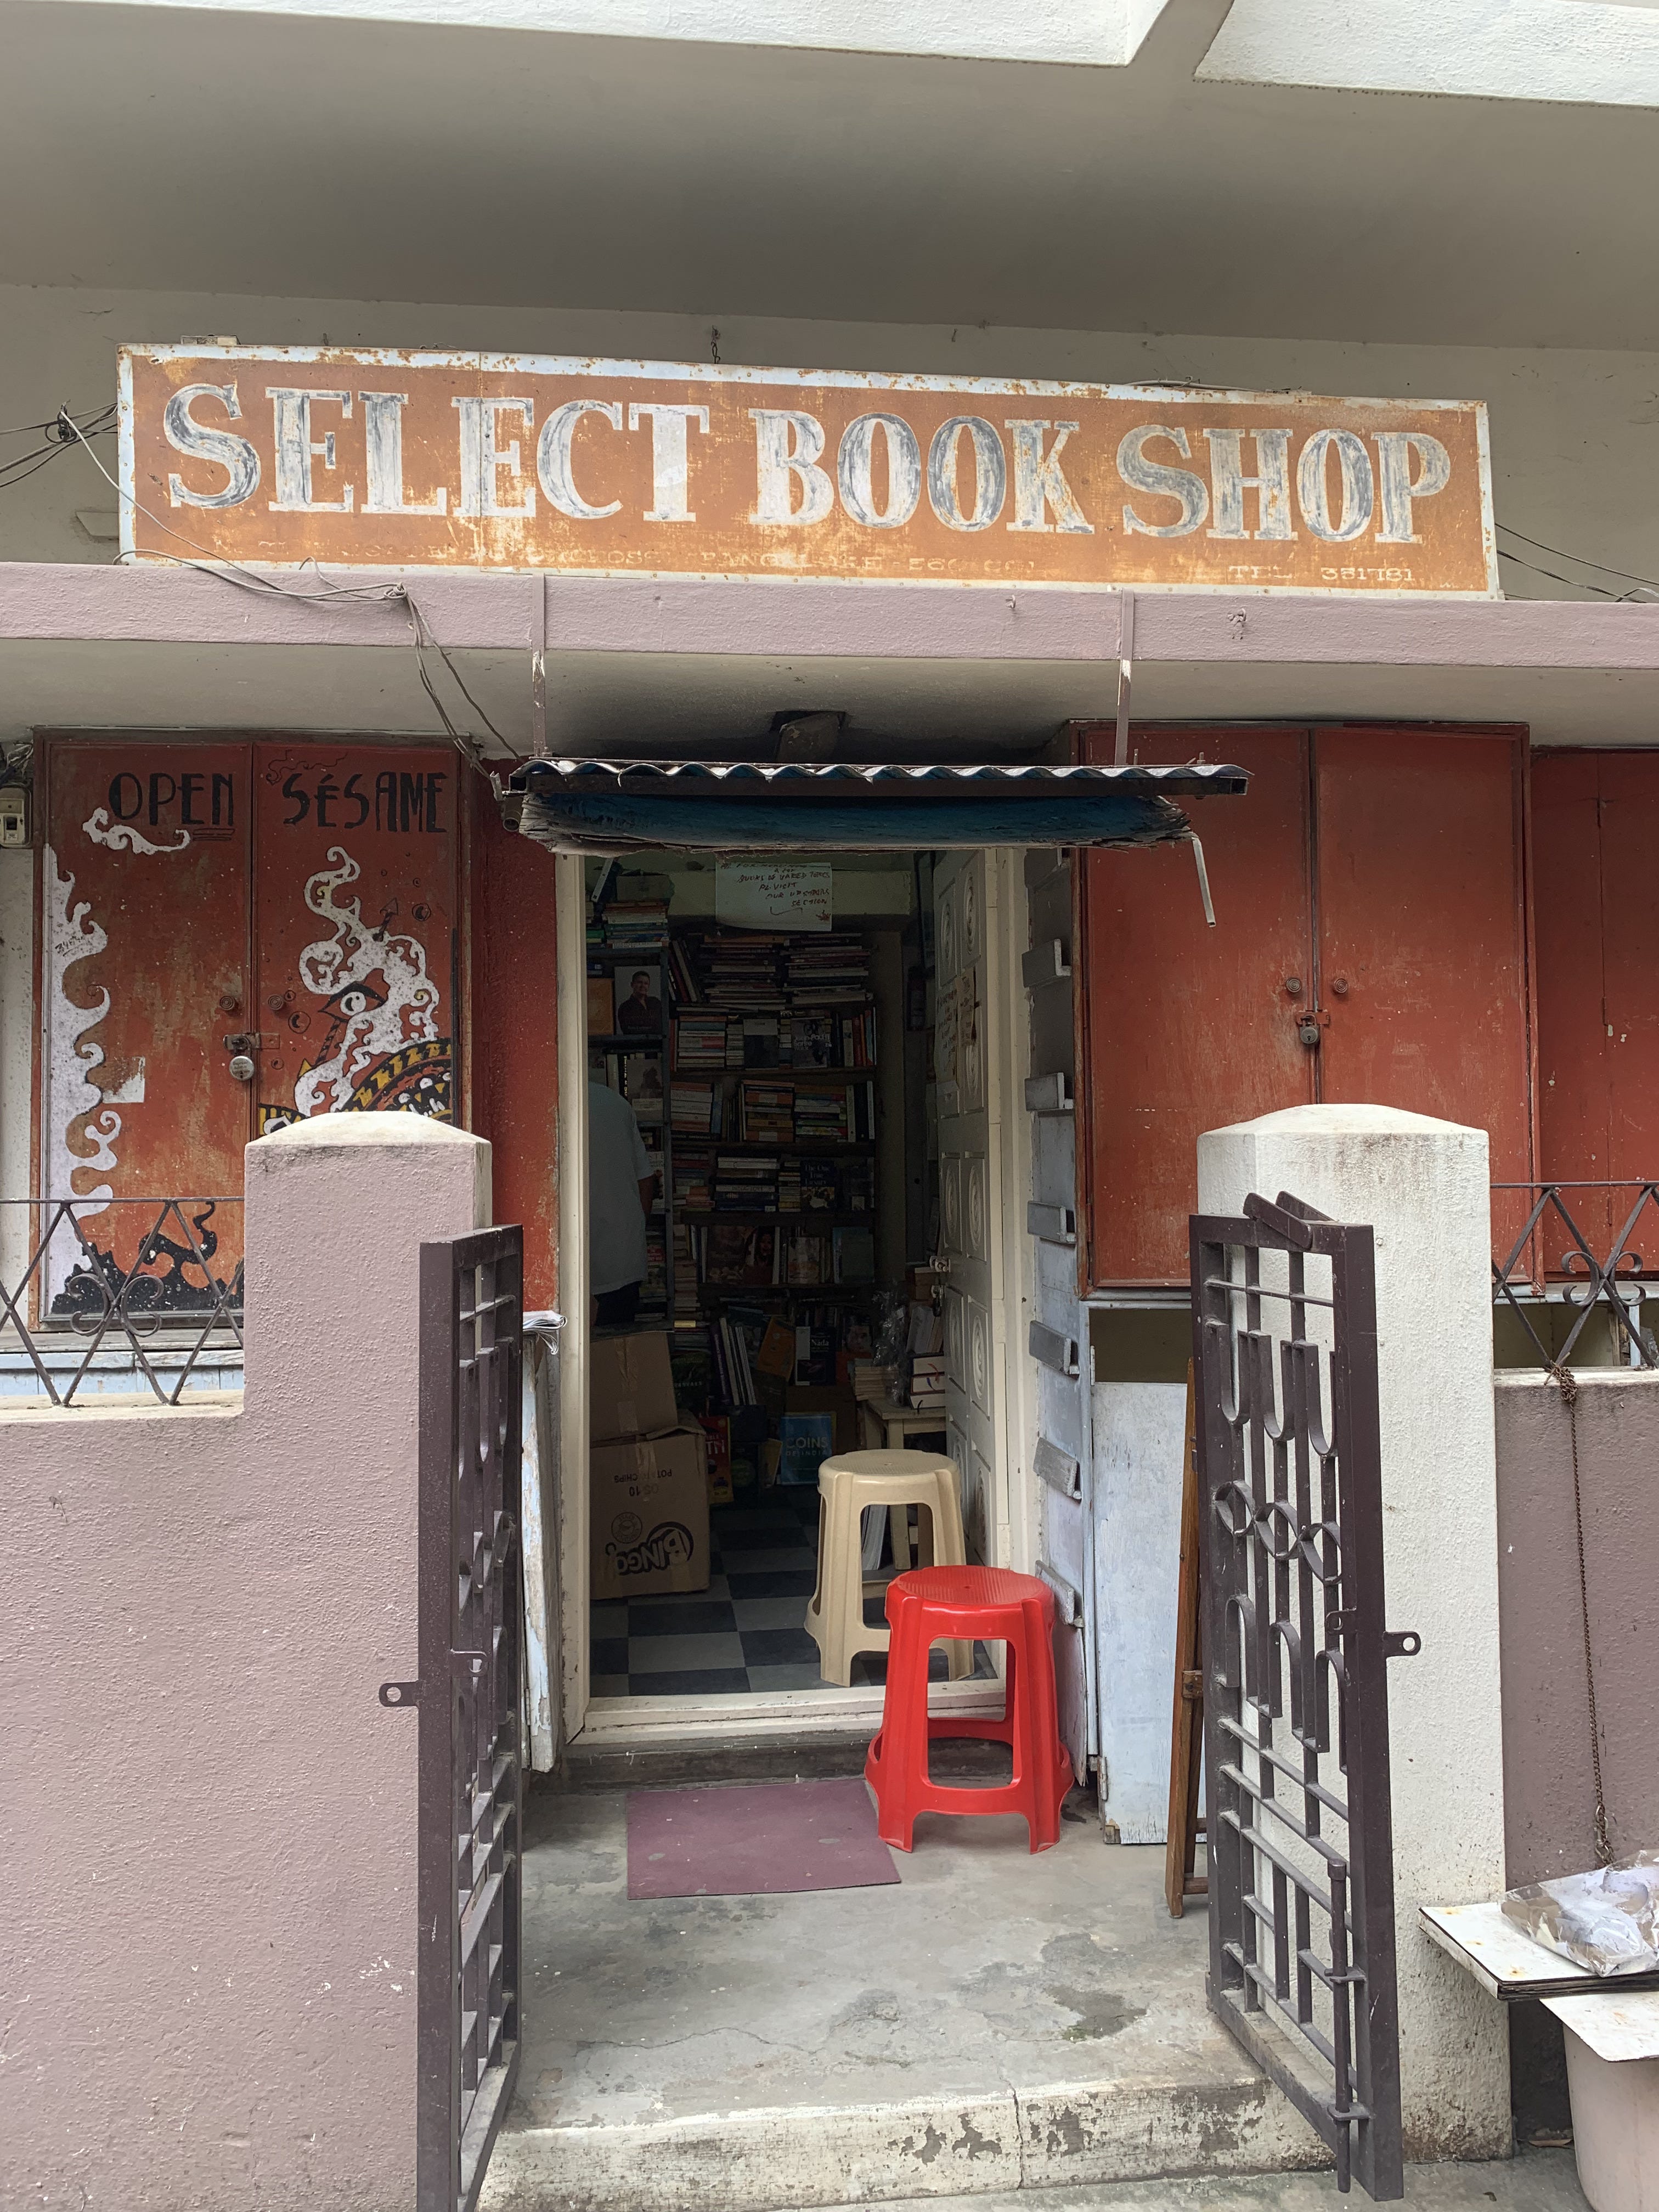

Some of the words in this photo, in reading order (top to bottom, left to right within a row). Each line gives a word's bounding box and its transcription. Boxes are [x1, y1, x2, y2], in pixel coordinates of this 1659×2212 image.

[163, 383, 710, 523] SELECT
[748, 408, 1095, 535] BOOK
[1118, 424, 1451, 544] SHOP
[109, 772, 234, 826] OPEN
[786, 1437, 828, 1449] COINS
[614, 1473, 639, 1483] CHIPS
[629, 1486, 641, 1497] 10
